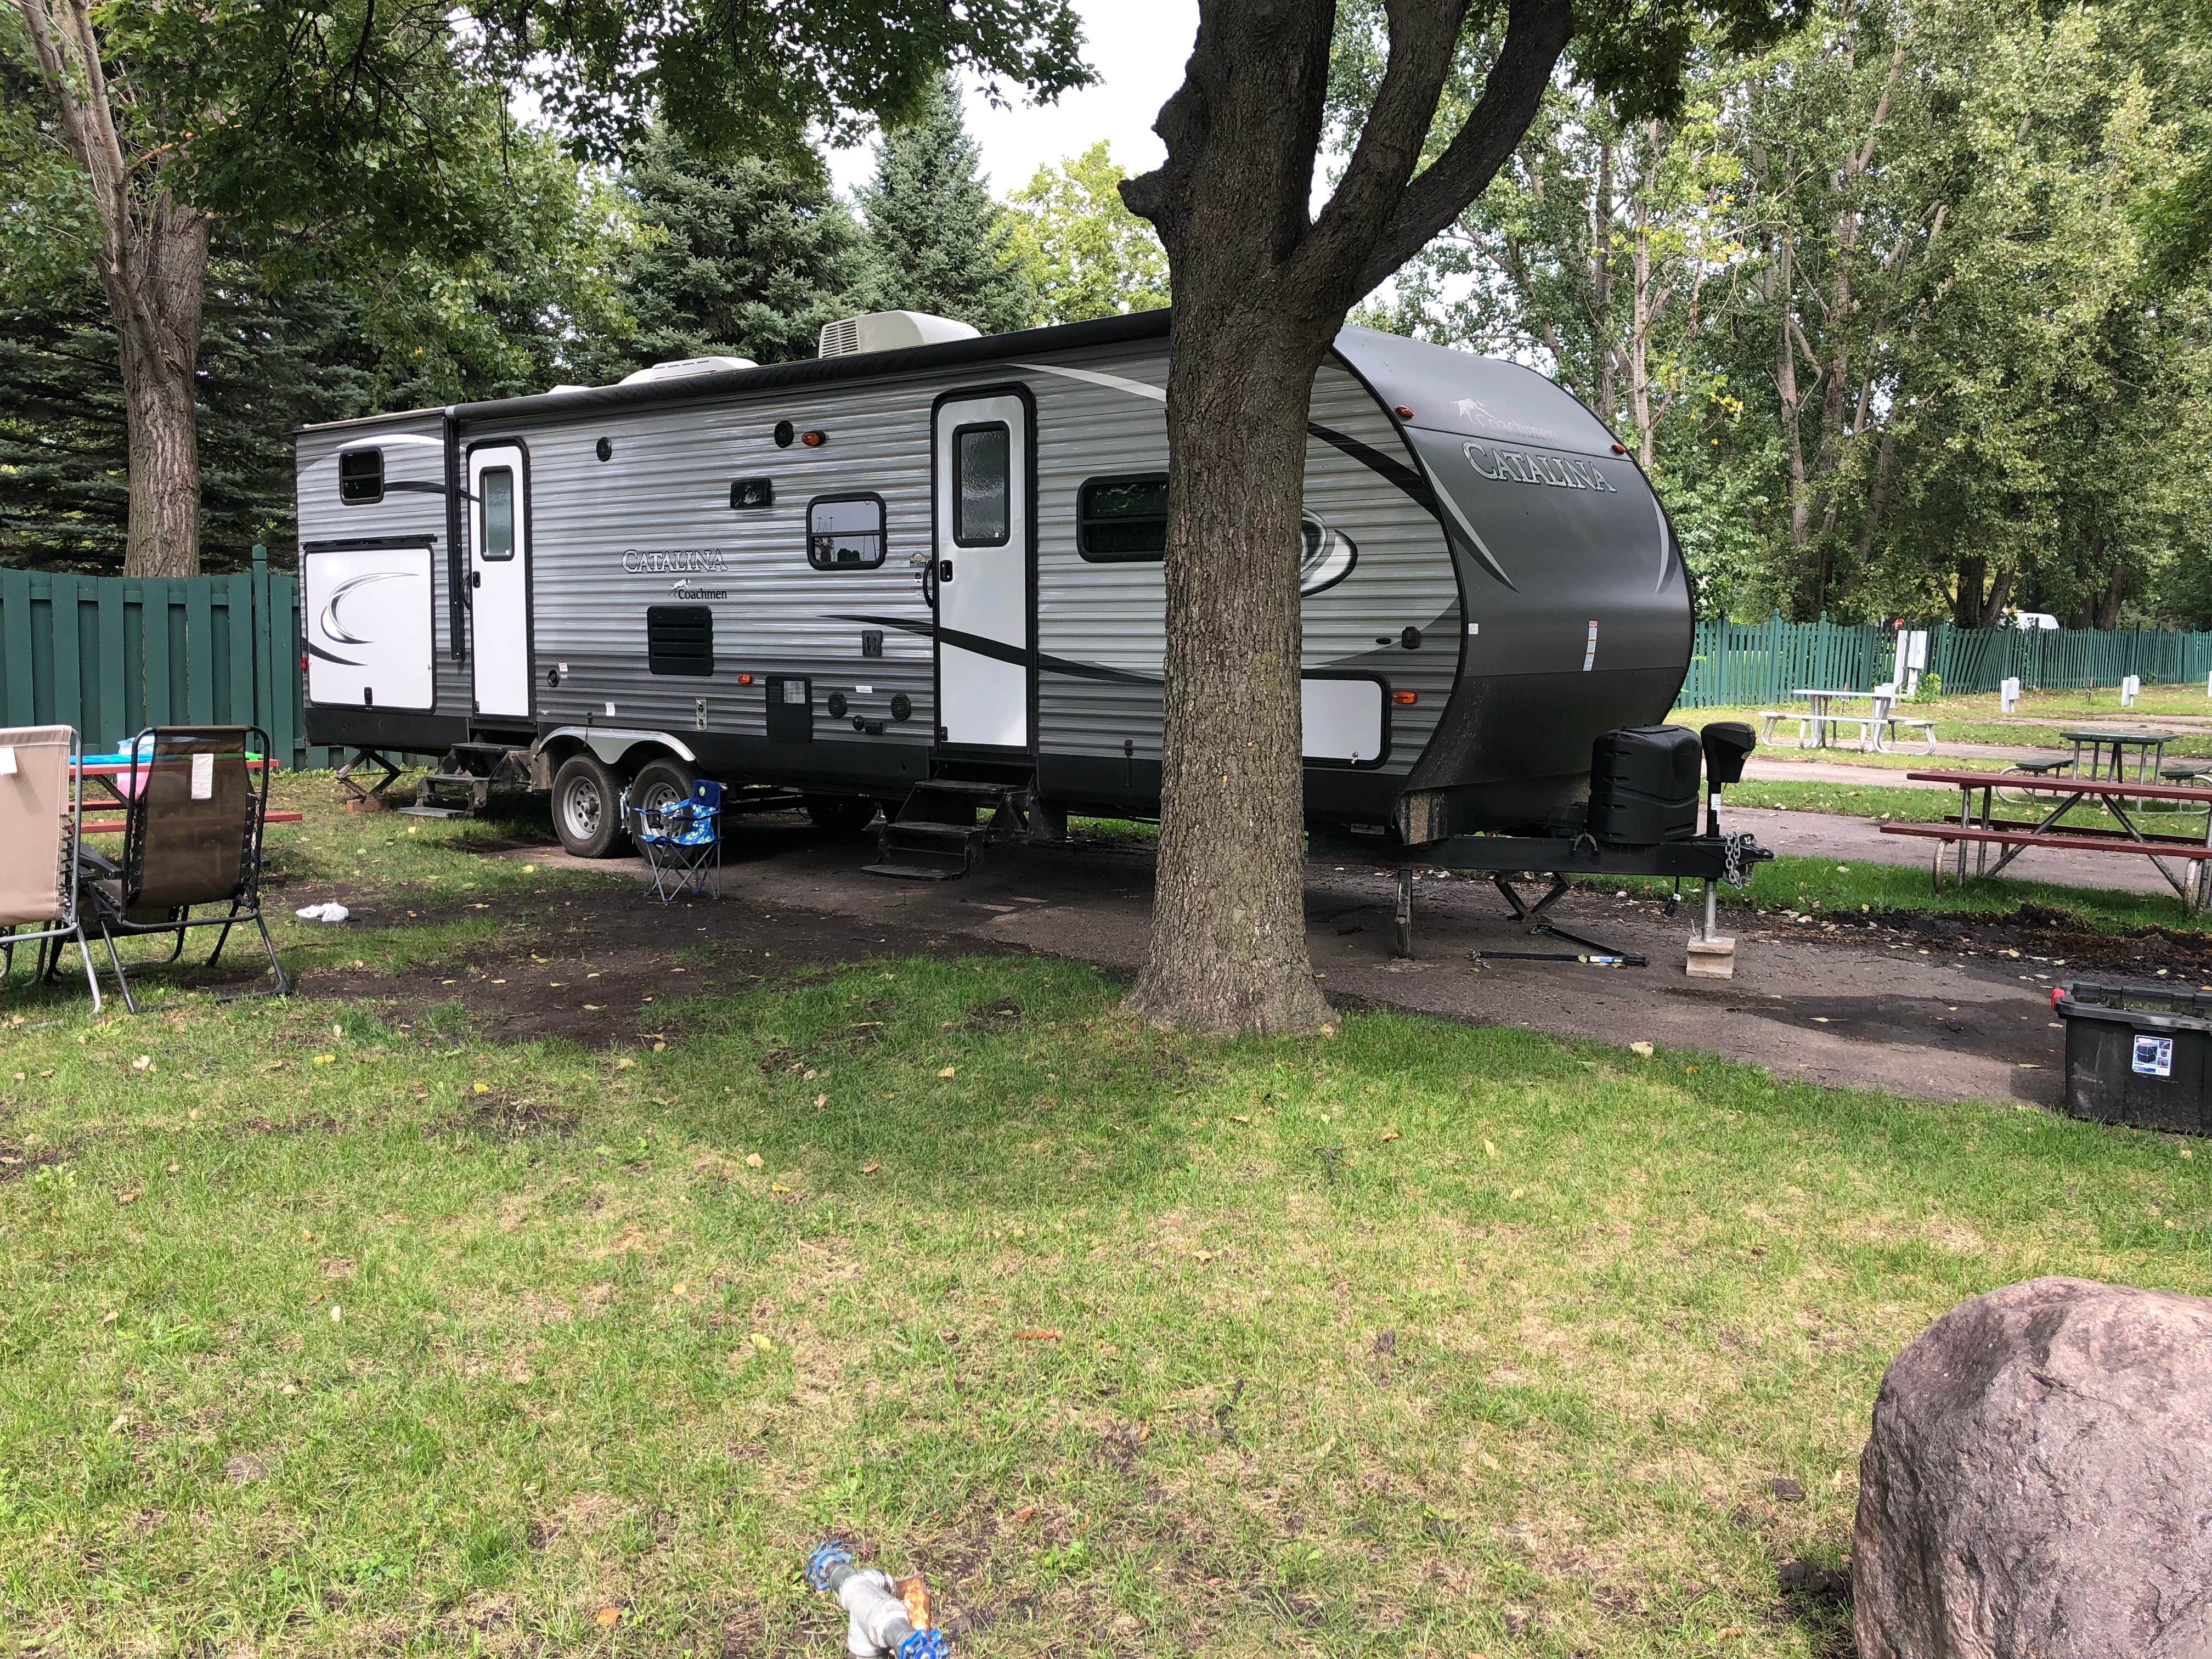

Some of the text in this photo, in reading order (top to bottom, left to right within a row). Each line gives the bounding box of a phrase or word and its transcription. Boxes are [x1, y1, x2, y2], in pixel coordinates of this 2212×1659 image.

[1462, 441, 1617, 493] CATALINA
[622, 549, 728, 573] CATALINA
[678, 588, 727, 600] Coachmen
